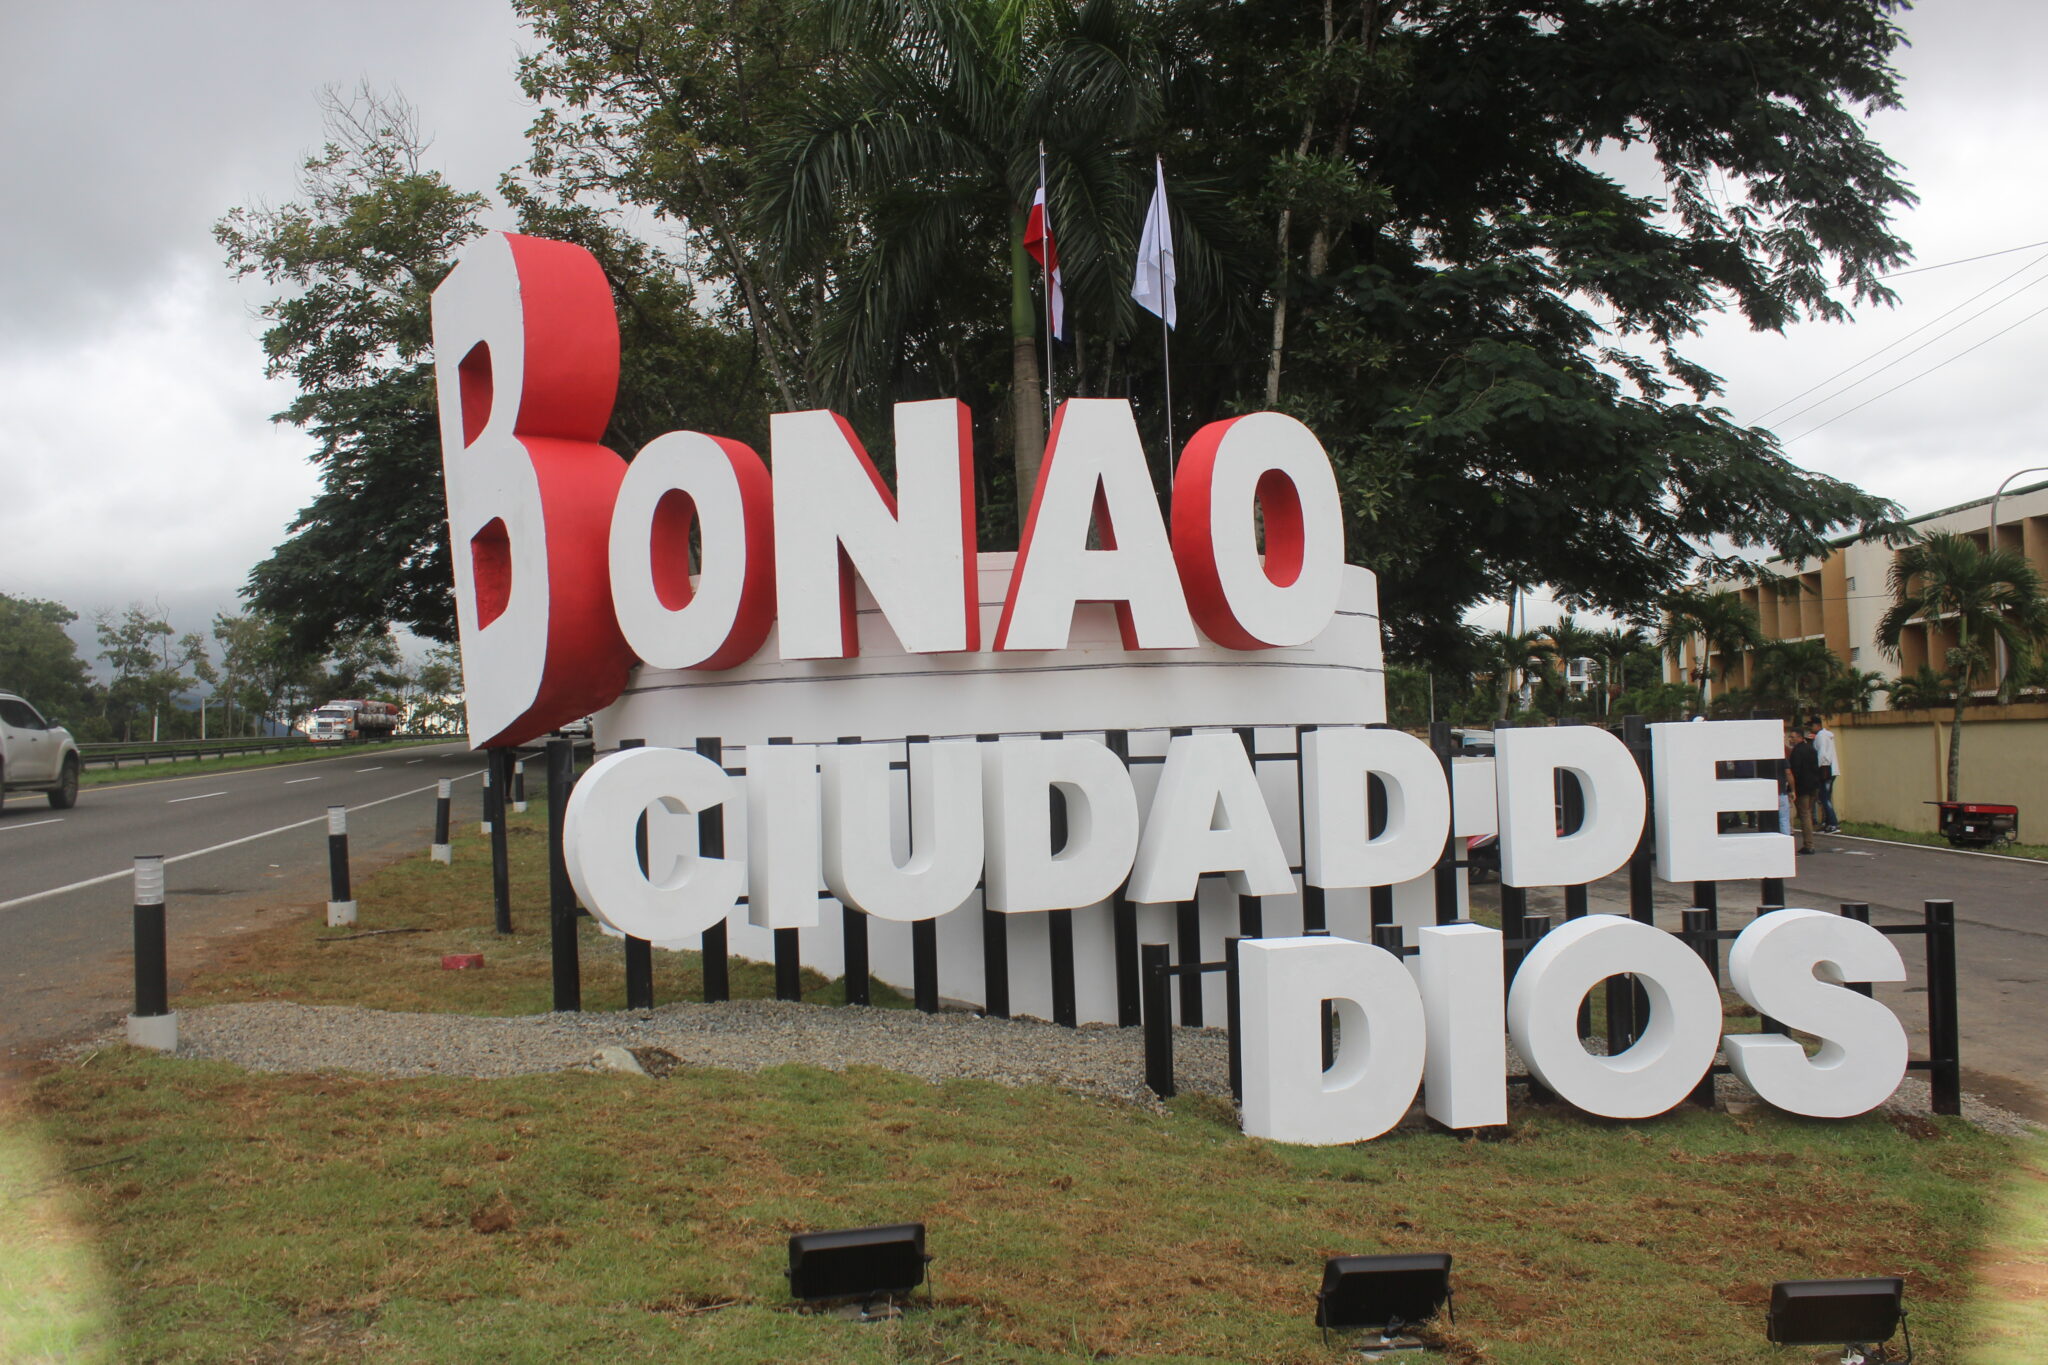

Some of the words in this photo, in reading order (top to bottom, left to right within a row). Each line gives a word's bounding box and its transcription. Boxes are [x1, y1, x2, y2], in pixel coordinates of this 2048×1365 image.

[430, 230, 1345, 750] BONAO
[562, 728, 1452, 942] CIUDAD
[1494, 718, 1797, 888] DE
[1237, 907, 1909, 1147] DIOS
